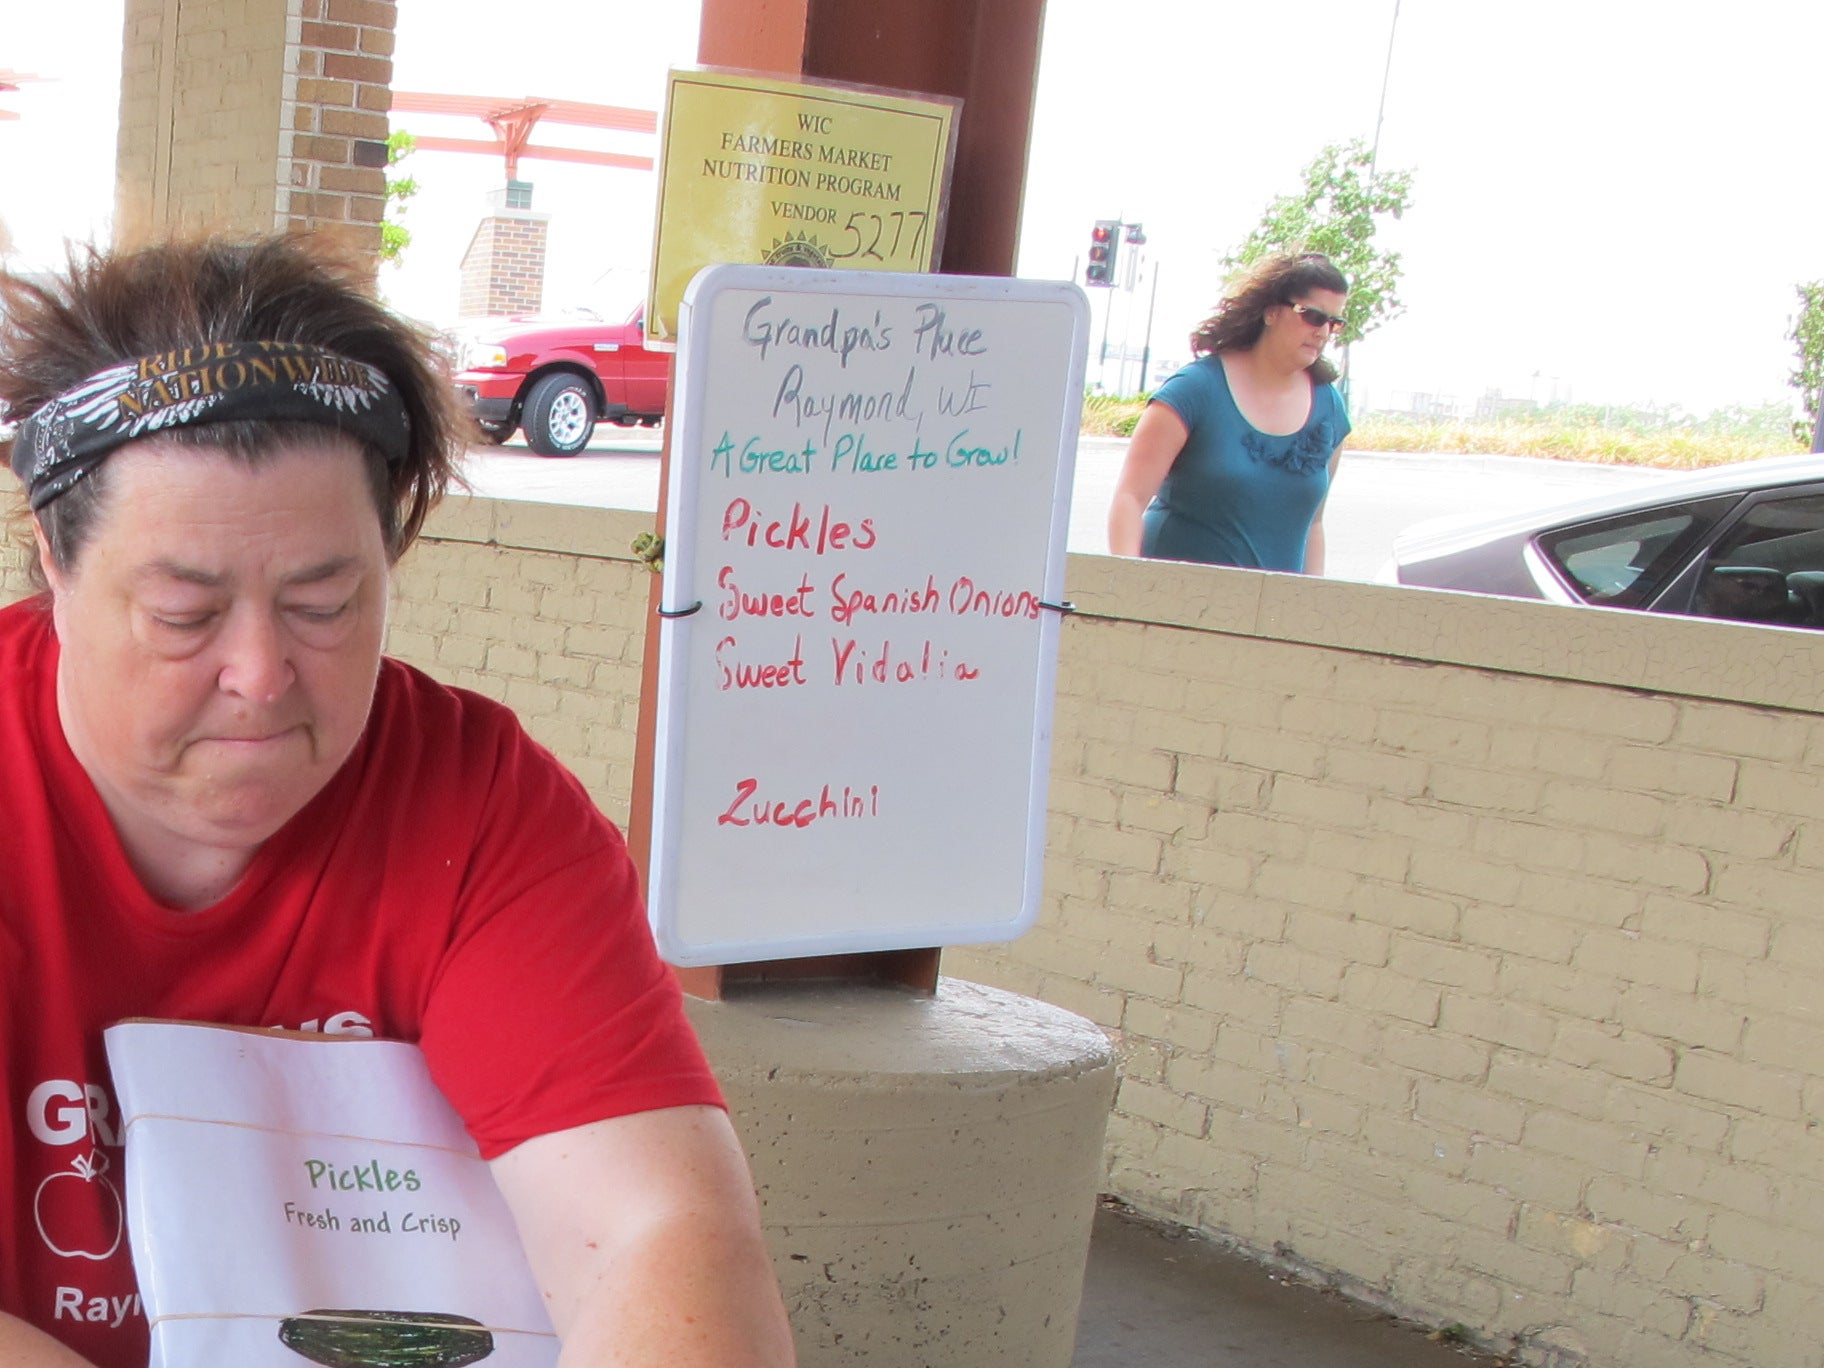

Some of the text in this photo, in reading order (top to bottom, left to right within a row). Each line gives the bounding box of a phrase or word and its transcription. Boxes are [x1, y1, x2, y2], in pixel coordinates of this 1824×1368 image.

[798, 113, 832, 135] WIC
[721, 132, 892, 172] FARMERS MARKET
[703, 158, 901, 201] NUTRITION PROGRAM
[770, 201, 836, 223] VENDOR
[827, 211, 927, 261] 5277
[743, 296, 893, 368] Grandpa's
[773, 364, 992, 447] Raymond, WI
[710, 428, 1022, 478] A Great Place to Grow!
[722, 498, 877, 555] Pickles
[717, 566, 1041, 626] Sweet Spanish Onions
[716, 633, 980, 691] Sweet Vidalia
[717, 777, 879, 828] Zucchini
[304, 1159, 421, 1192] Pickles
[284, 1202, 461, 1241] Fresh and Crisp
